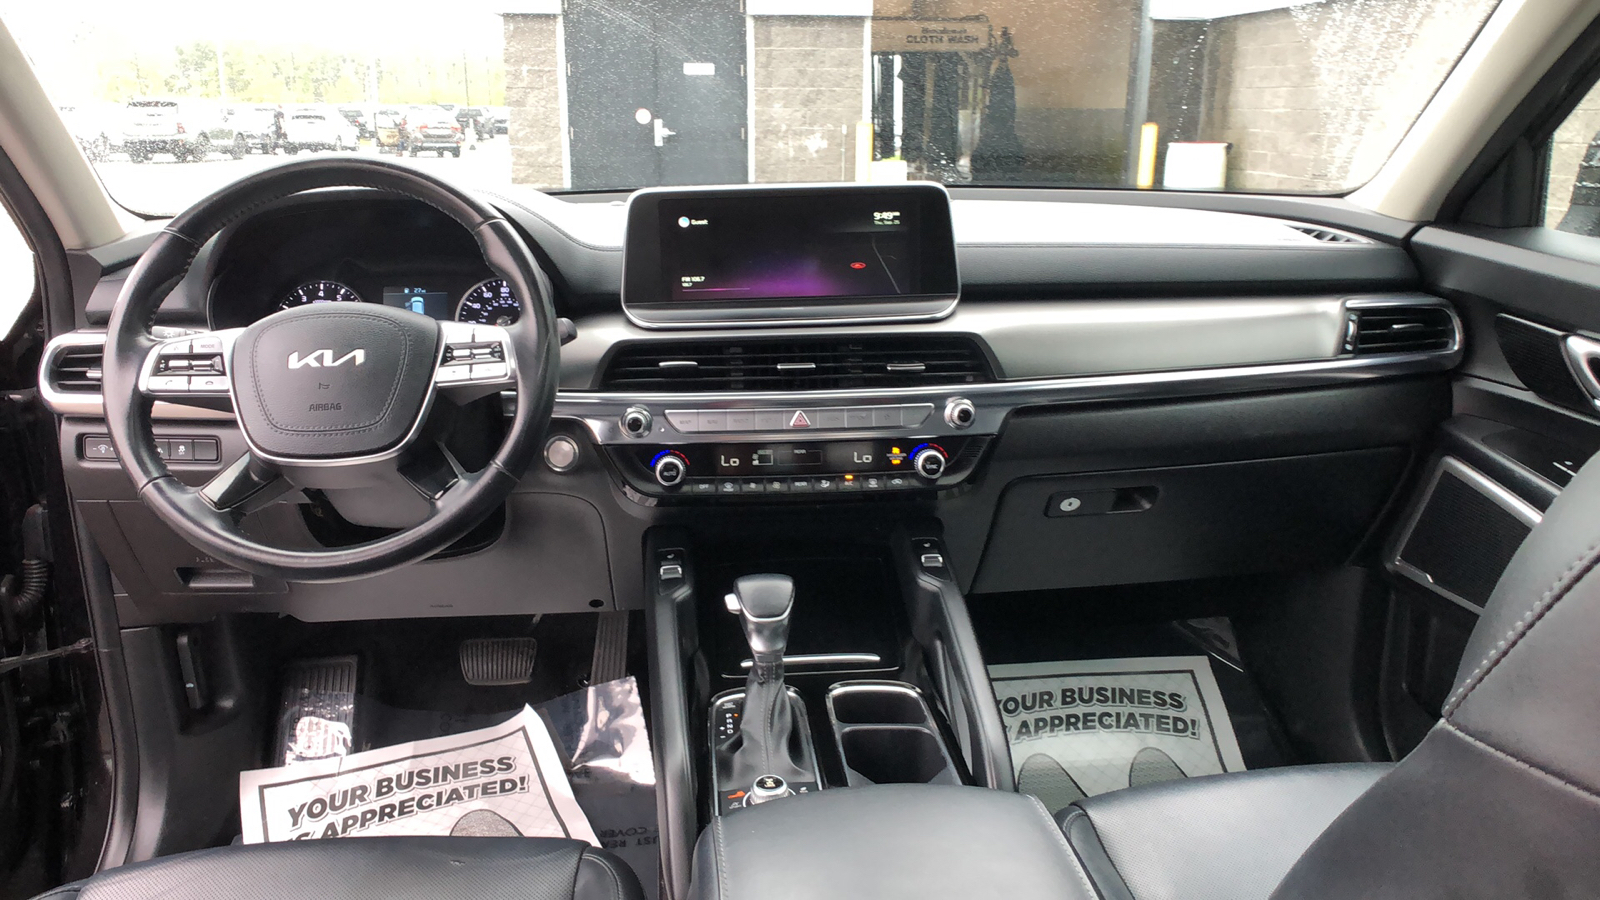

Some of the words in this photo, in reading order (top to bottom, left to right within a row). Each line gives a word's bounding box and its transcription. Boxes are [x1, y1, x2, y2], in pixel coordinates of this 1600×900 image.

[906, 35, 944, 44] CLOTH
[948, 35, 979, 44] WASH
[288, 349, 365, 369] KIA
[308, 402, 342, 412] AIRBAG
[720, 455, 740, 467] Lo
[853, 451, 873, 463] Lo
[1061, 686, 1185, 709] BUSINESS
[1014, 711, 1198, 741] APPRECIATED!
[287, 785, 369, 828] YOUR
[375, 756, 513, 798] BUSINESS
[320, 776, 527, 839] APPRECIATED!
